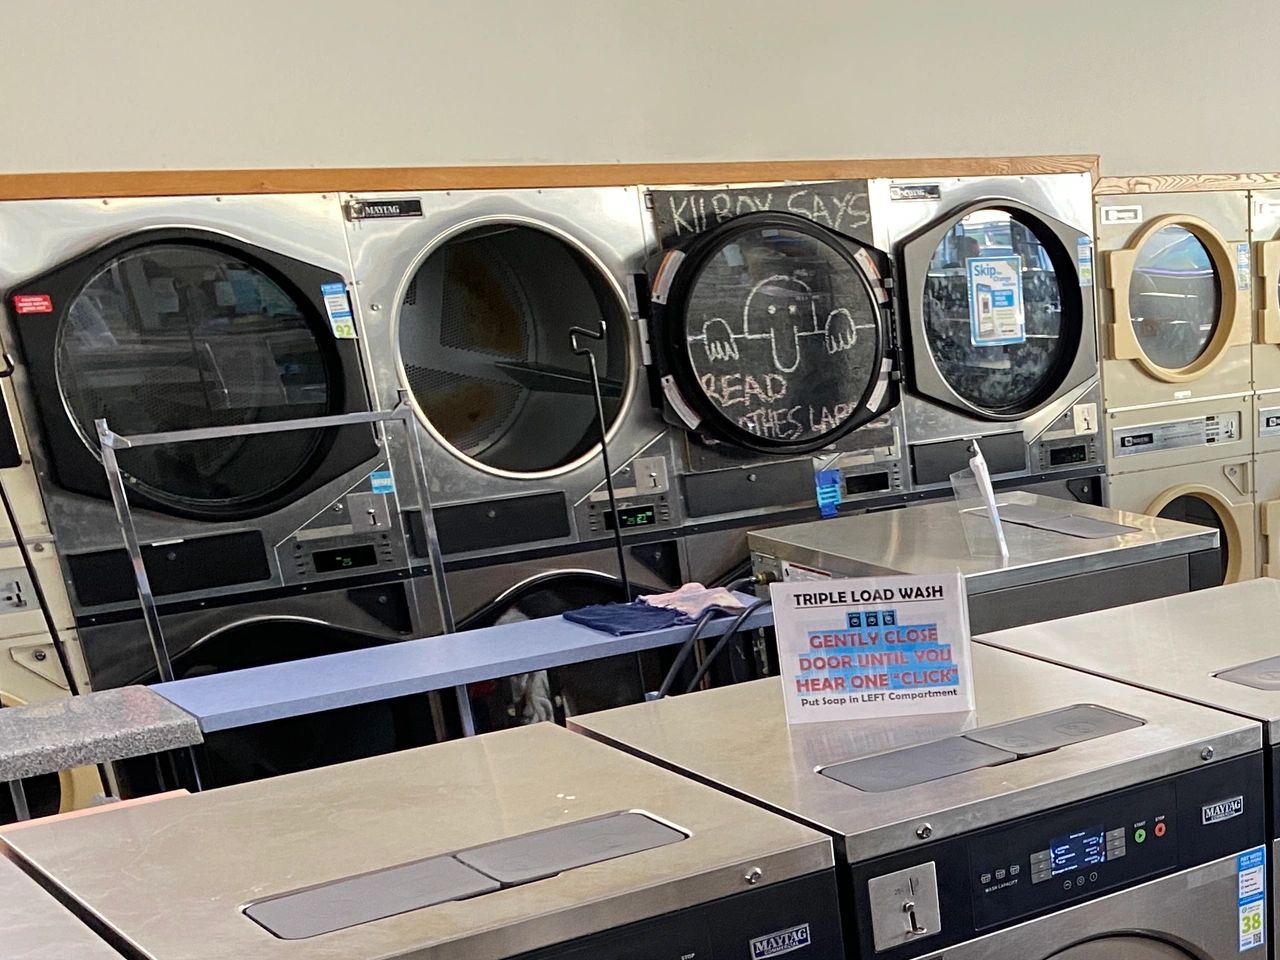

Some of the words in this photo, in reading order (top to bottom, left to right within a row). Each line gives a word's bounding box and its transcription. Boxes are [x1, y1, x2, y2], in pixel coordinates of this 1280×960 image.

[365, 205, 400, 214] MAYTAG
[788, 190, 871, 231] SAYS
[974, 263, 997, 278] Skip
[335, 324, 353, 337] 92
[701, 373, 787, 407] READ
[794, 591, 847, 606] TRIPLE
[851, 588, 894, 602] LOAD
[899, 585, 943, 599] WASH
[809, 632, 879, 648] GENTLY
[884, 628, 938, 644] CLOSE
[799, 655, 851, 671] DOOR
[857, 651, 909, 667] UNTIL
[914, 648, 952, 663] YOU
[796, 676, 845, 693] HEAR
[851, 673, 889, 688] ONE
[801, 698, 819, 707] Put
[822, 696, 846, 707] Soap
[849, 695, 859, 704] in
[861, 693, 885, 703] LEFT
[888, 688, 958, 701] Compartment
[1205, 800, 1241, 818] MAYTAG
[1242, 912, 1261, 935] 38
[755, 928, 807, 954] MAYTAG
[681, 953, 695, 960] STOP
